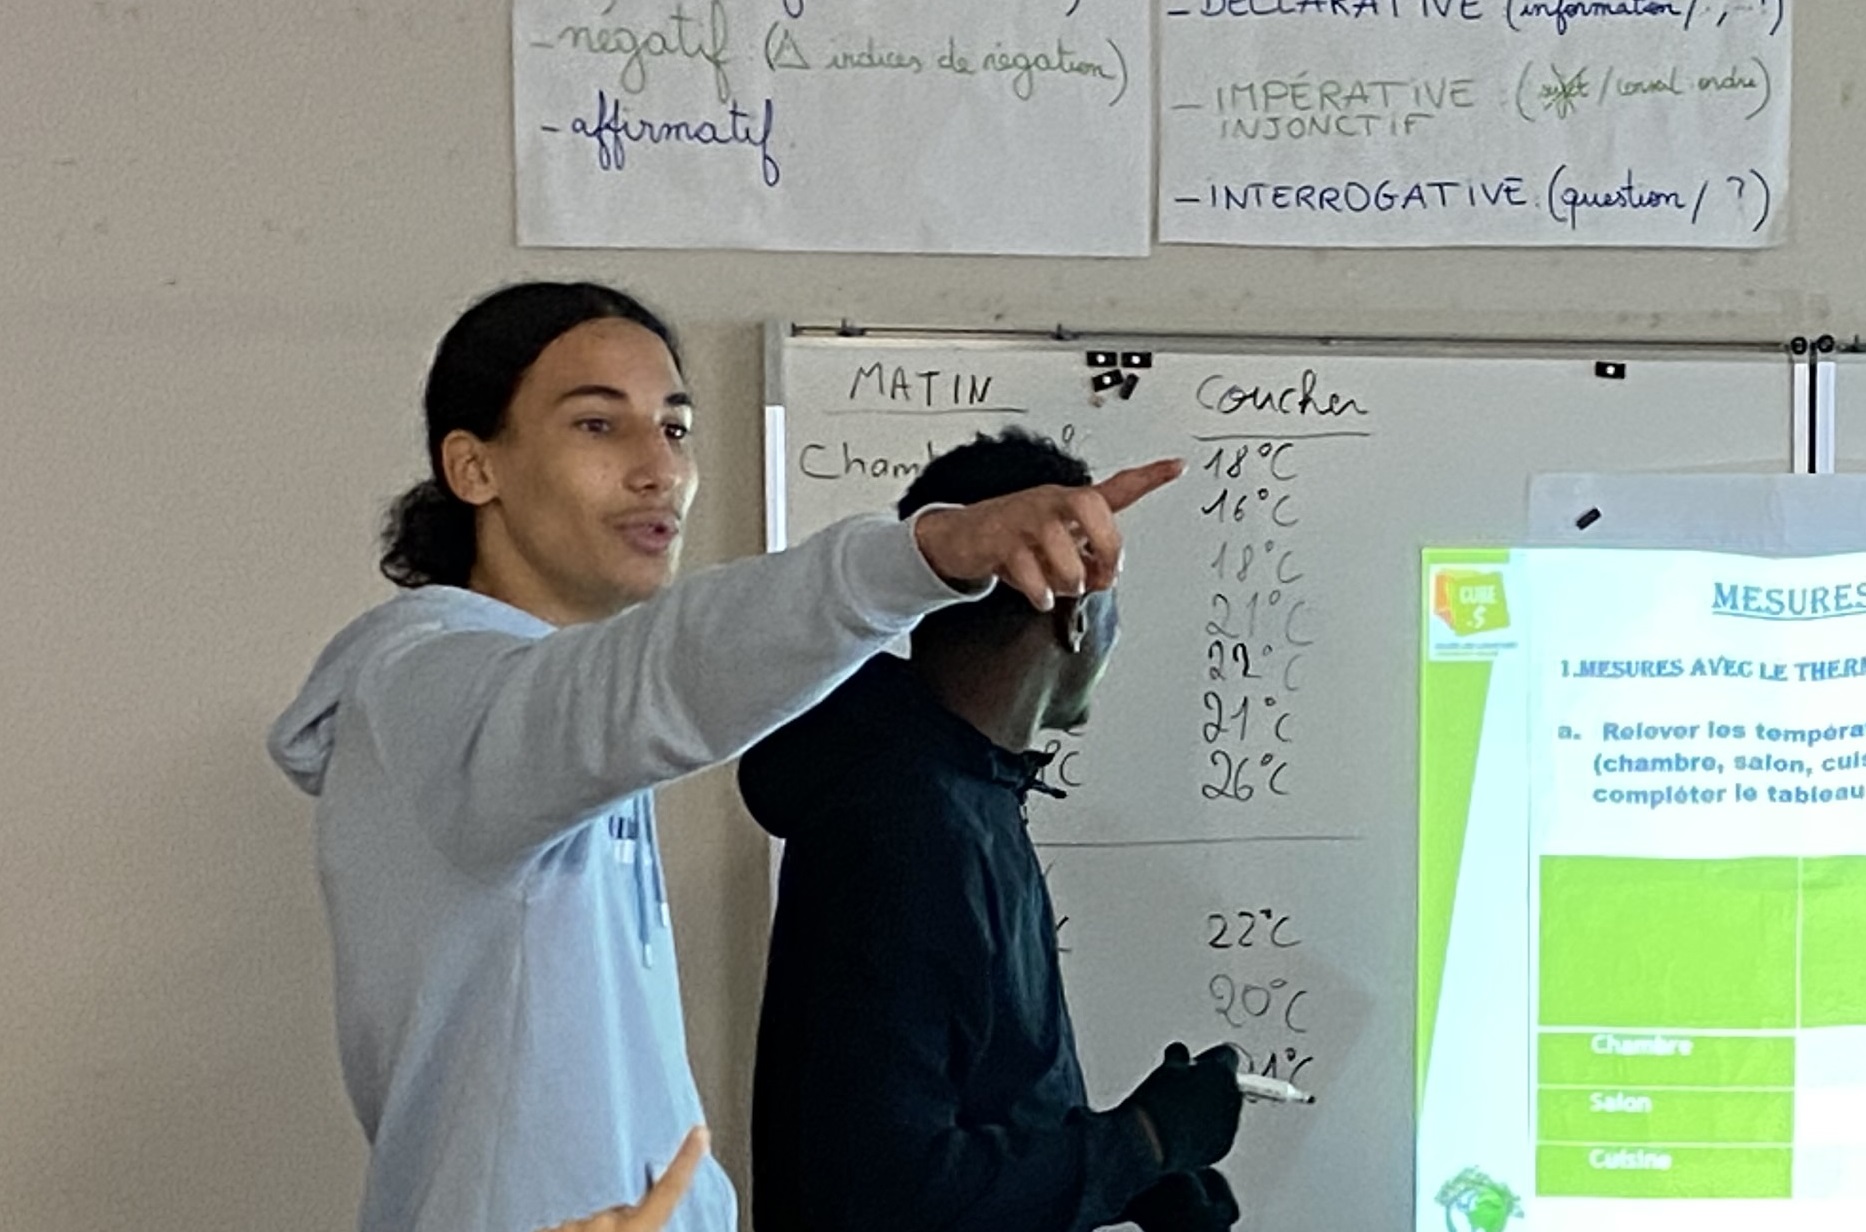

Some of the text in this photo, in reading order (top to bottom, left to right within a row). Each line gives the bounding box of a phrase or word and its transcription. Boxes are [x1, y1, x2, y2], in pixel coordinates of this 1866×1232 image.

[937, 37, 975, 75] de
[1220, 113, 1434, 140] INJONCTIF
[850, 361, 992, 406] MATIN
[1203, 442, 1299, 481] 18°C
[1201, 489, 1300, 528] 16°C
[1690, 655, 1753, 679] AVEC
[1760, 661, 1788, 682] LE
[1202, 691, 1292, 743] 21°C
[1202, 752, 1290, 801] 26°C
[1733, 753, 1814, 778] salon,
[1208, 908, 1303, 949] 22°C
[1209, 973, 1308, 1033] 20°C
[1592, 1034, 1692, 1055] Chambre
[1590, 1092, 1652, 1113] Salon
[1590, 1149, 1672, 1170] Cuisine
